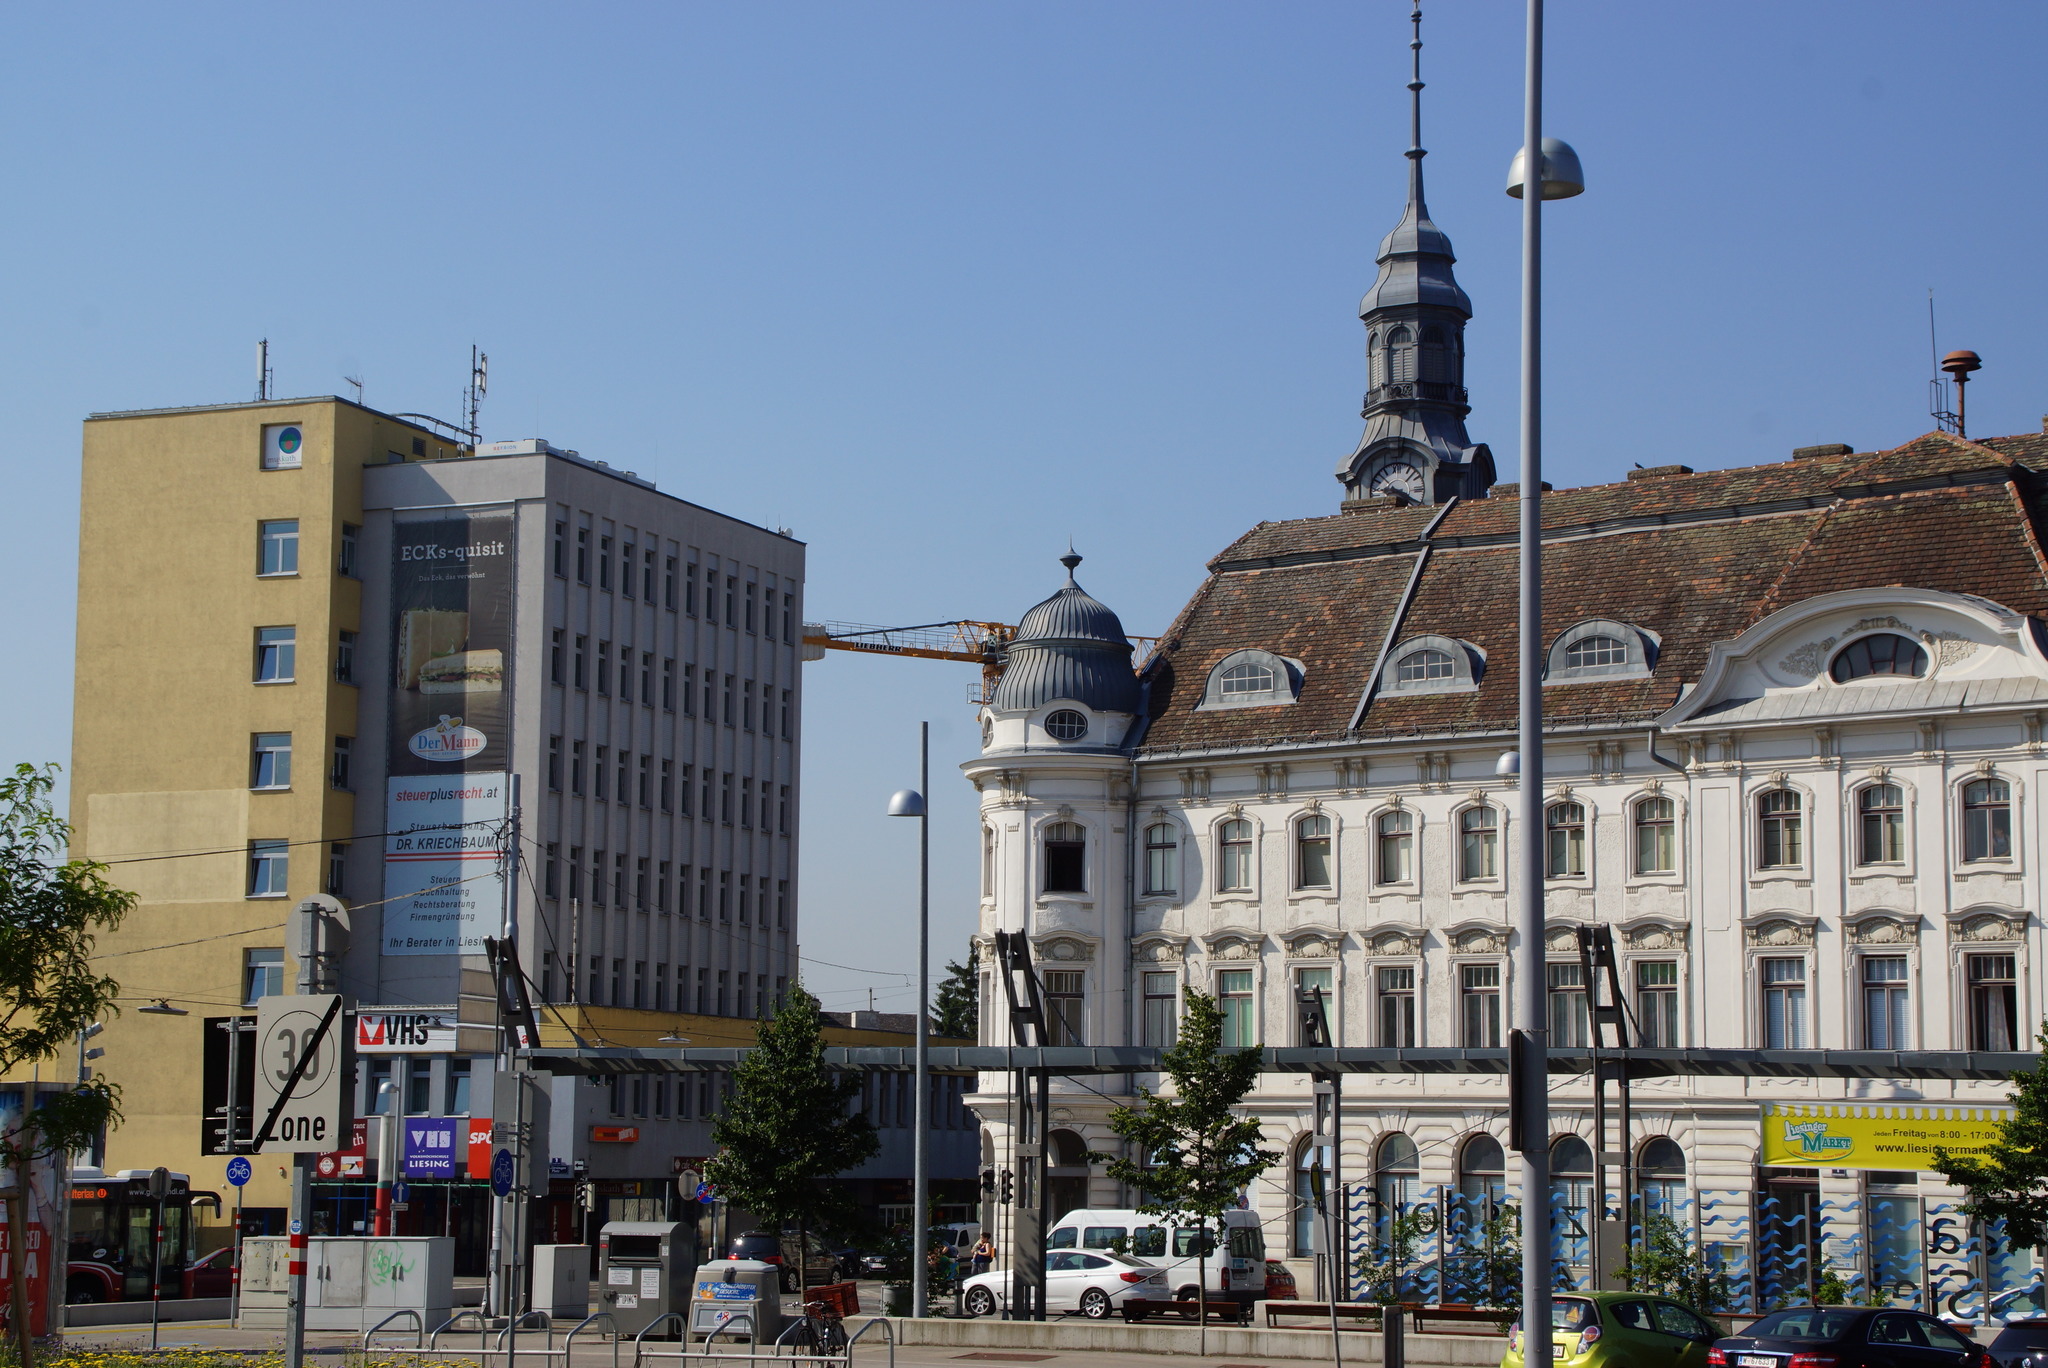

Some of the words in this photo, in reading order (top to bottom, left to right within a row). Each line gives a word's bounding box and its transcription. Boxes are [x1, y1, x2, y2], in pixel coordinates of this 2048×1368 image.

[401, 541, 504, 563] ECKs-quisit
[855, 642, 902, 652] LIEBHERR
[396, 786, 498, 803] steuerplusrecht.at
[396, 838, 414, 850] DR.
[417, 836, 495, 850] KRIECHBAUM
[430, 875, 461, 884] Steuern
[413, 900, 476, 909] Rechtsberatung
[410, 913, 475, 922] Firmengründung
[390, 937, 403, 948] Ihr
[406, 937, 442, 948] Berater
[445, 936, 455, 947] in
[458, 936, 486, 947] Liesi
[385, 1014, 429, 1046] VHS
[276, 1027, 320, 1082] 30
[266, 1108, 326, 1142] Zone
[411, 1130, 451, 1148] VHS
[1892, 1128, 1927, 1139] Freitag
[1939, 1130, 1961, 1139] 8:00
[1970, 1131, 1996, 1140] 17:00
[409, 1160, 450, 1168] LIESING
